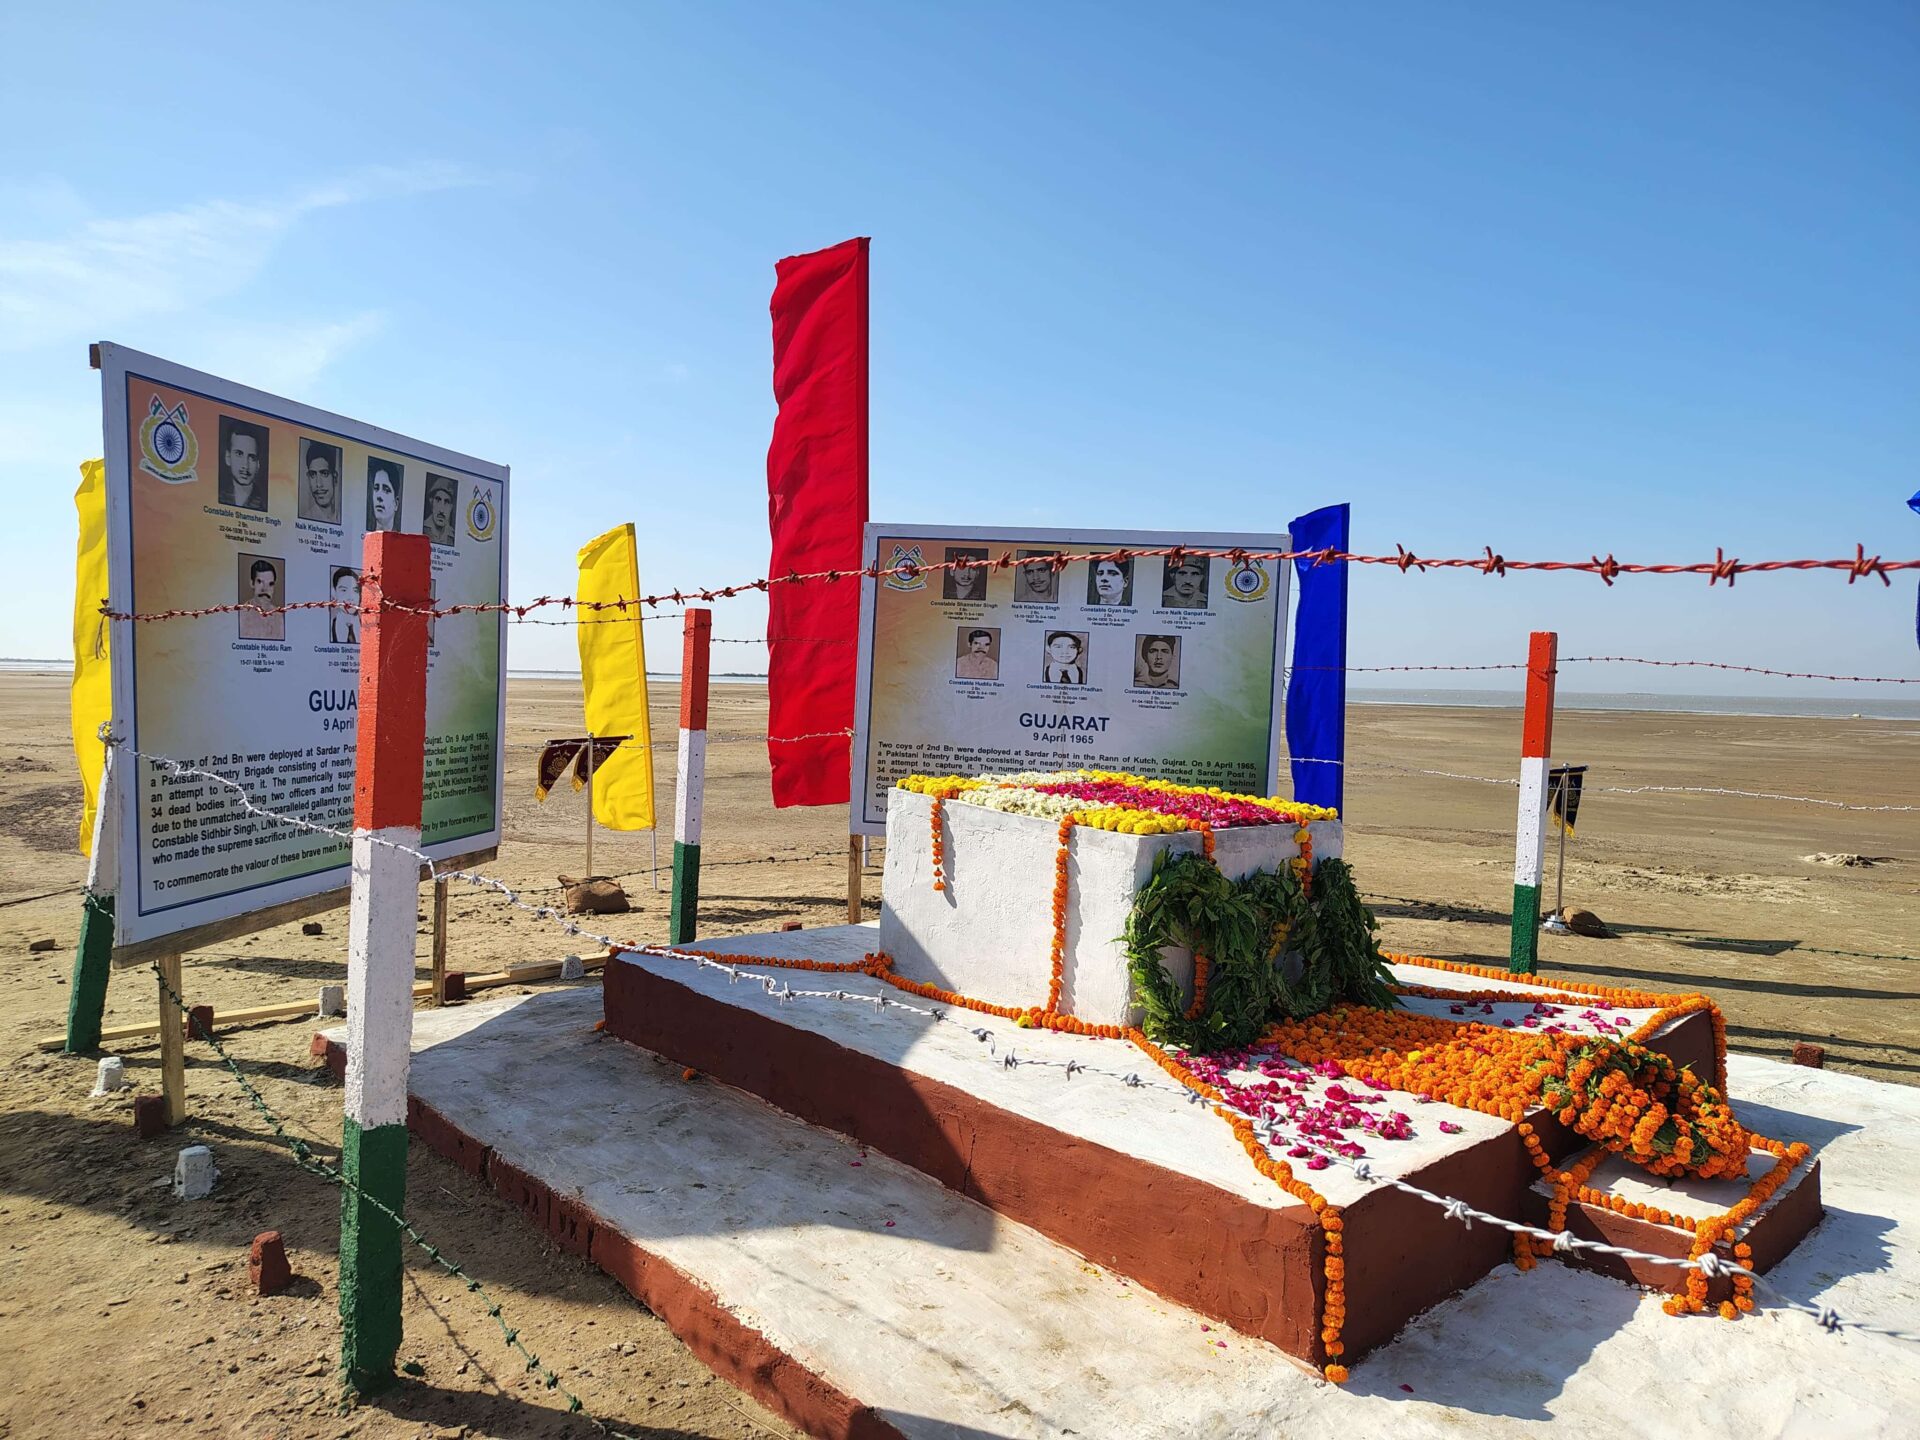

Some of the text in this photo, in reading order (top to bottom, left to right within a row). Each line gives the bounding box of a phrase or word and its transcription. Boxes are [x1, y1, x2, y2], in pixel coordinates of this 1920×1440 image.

[203, 505, 281, 526] Constable Shamsher Singh
[308, 524, 328, 534] Kishore
[329, 526, 344, 537] Singh
[231, 642, 260, 651] Constable
[324, 717, 355, 732] 9 April
[1019, 712, 1110, 732] GUJARAT
[1033, 732, 1094, 744] 9 April 1965
[200, 756, 208, 767] of
[212, 754, 228, 766] 2nd
[232, 753, 244, 764] Bn
[247, 753, 266, 762] were
[269, 748, 303, 761] deployed
[306, 748, 314, 757] at
[316, 745, 340, 756] Sardar
[886, 750, 919, 758] Pakistani
[922, 752, 950, 762] Infantry
[954, 754, 982, 763] Brigade
[986, 756, 1024, 766] consisting
[1040, 760, 1062, 768] nearly
[1088, 762, 1116, 770] officers
[1160, 768, 1193, 776] attacked
[978, 747, 1011, 756] deployed
[1134, 757, 1158, 766] Kutch,
[1162, 758, 1187, 766] Gujrat.
[1214, 762, 1233, 770] April
[1236, 762, 1256, 770] 1965,
[150, 778, 156, 788] a
[244, 765, 274, 778] Brigade
[278, 762, 316, 774] consisting
[320, 759, 328, 768] of
[332, 757, 352, 768] nearly
[1196, 778, 1224, 786] leaving
[151, 793, 162, 802] an
[169, 788, 204, 800] attempt
[210, 786, 218, 796] to
[272, 777, 286, 787] The
[292, 772, 333, 784] numerically
[152, 807, 162, 818] 34
[168, 803, 190, 816] dead
[196, 800, 225, 811] bodies
[272, 792, 284, 802] two
[289, 788, 317, 799] officers
[320, 784, 334, 794] and
[338, 782, 352, 792] four
[152, 823, 170, 834] due
[172, 820, 182, 830] to
[184, 818, 198, 829] the
[200, 810, 246, 826] unmatched
[311, 797, 341, 810] gallantry
[152, 832, 199, 849] Constable
[201, 826, 232, 840] Sidhbir
[234, 822, 260, 837] Singh,
[328, 809, 336, 818] Ct
[152, 852, 172, 864] who
[175, 847, 200, 860] made
[202, 844, 216, 856] the
[218, 838, 253, 853] supreme
[254, 832, 287, 846] sacrifice
[289, 830, 296, 838] of
[153, 880, 165, 891] To
[168, 867, 229, 888] commemorate
[231, 864, 244, 874] the
[246, 860, 269, 871] valour
[272, 854, 279, 866] of
[280, 852, 300, 864] these
[302, 849, 321, 859] brave
[322, 844, 337, 854] men
[338, 842, 343, 850] 9
